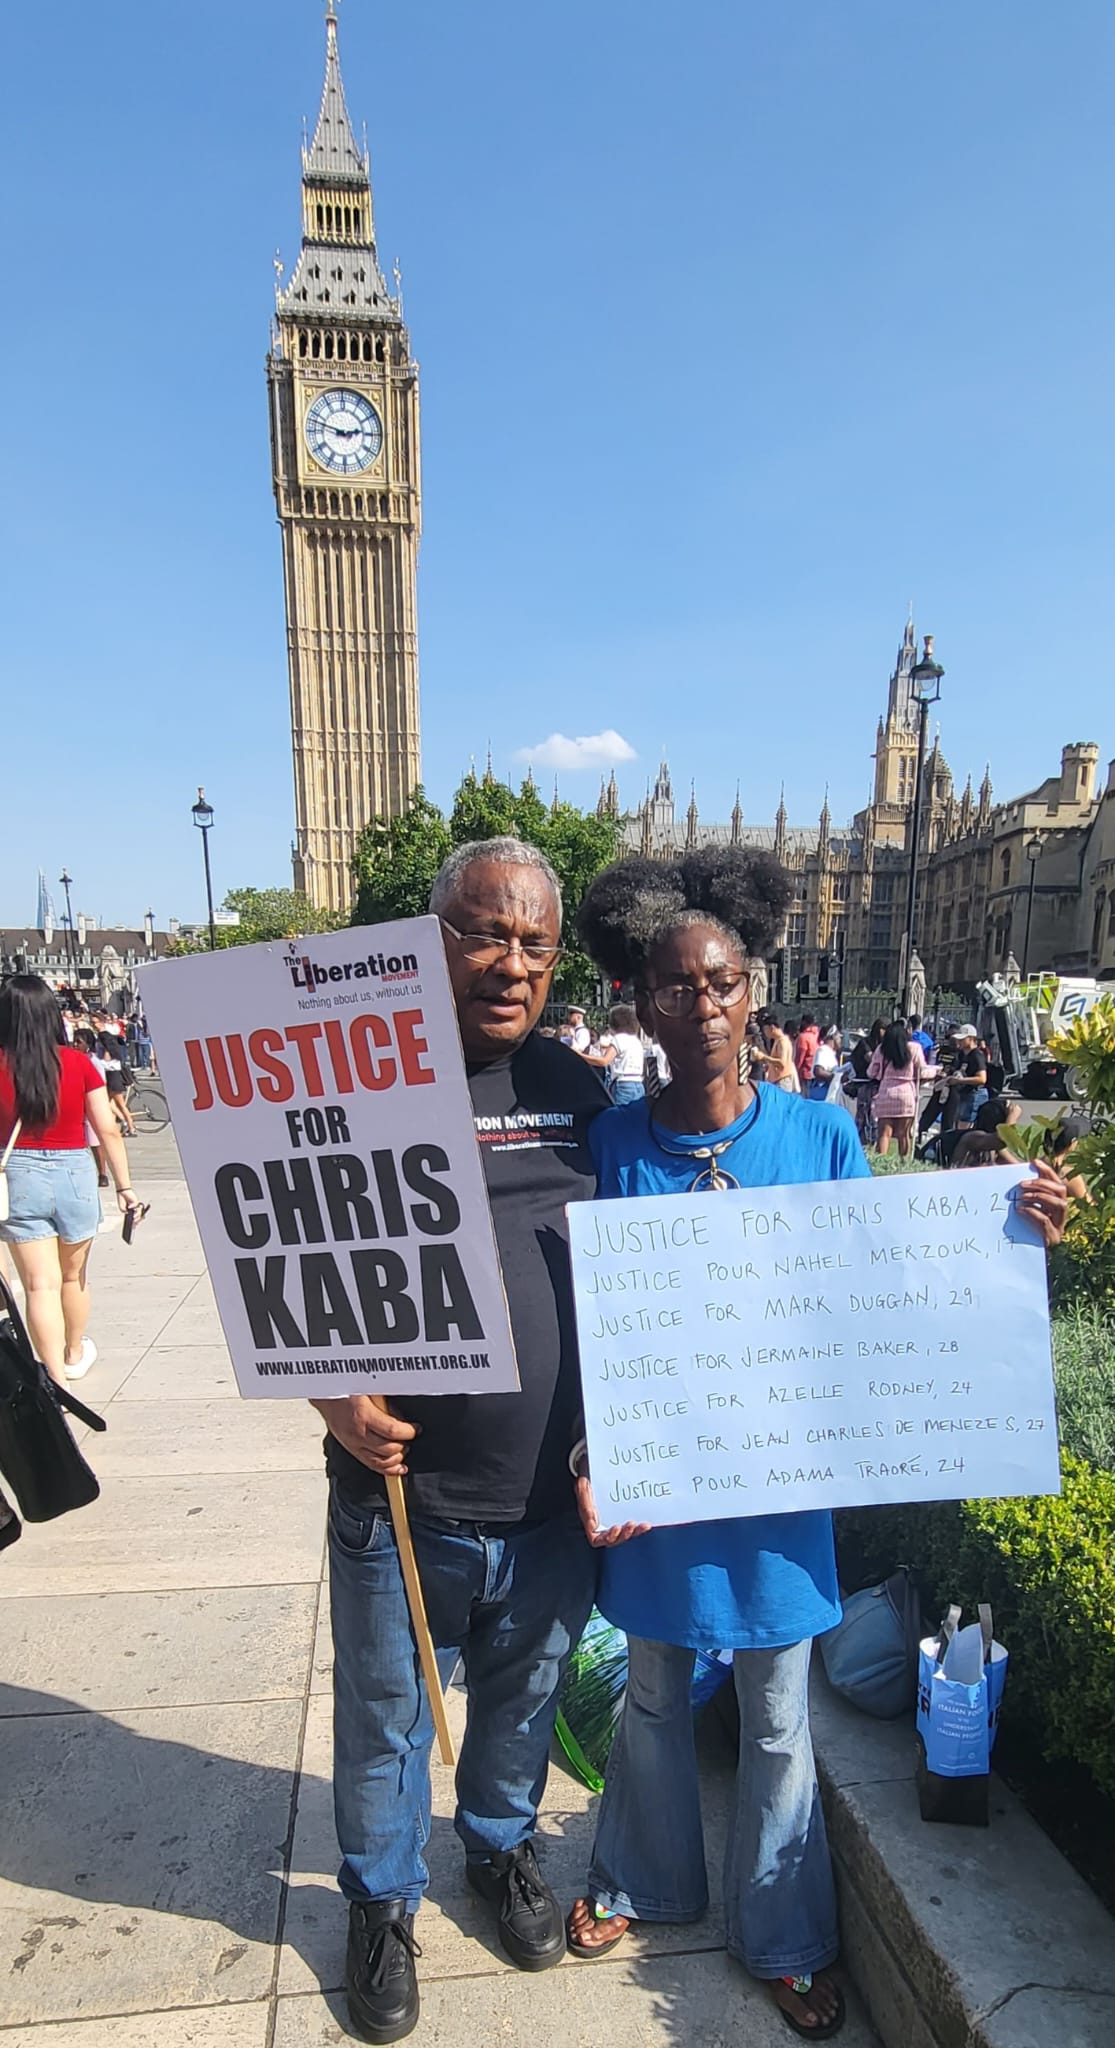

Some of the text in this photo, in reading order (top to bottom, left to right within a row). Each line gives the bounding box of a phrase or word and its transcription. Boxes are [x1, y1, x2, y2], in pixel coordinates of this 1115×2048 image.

[283, 955, 301, 967] The
[291, 953, 418, 988] Liberation
[382, 970, 419, 982] MOVEMENT
[298, 984, 422, 1010] Nothing about us, without us
[185, 1009, 436, 1111] JUSTICE
[285, 1105, 352, 1149] FOR
[504, 1113, 574, 1130] MOVEMENT
[507, 1130, 529, 1140] about
[214, 1144, 461, 1249] CHRIS
[583, 1215, 709, 1257] JUSTICE
[741, 1209, 792, 1238] FOR
[811, 1202, 882, 1230] CHRIS
[908, 1195, 978, 1219] KABA,
[586, 1235, 1015, 1294] JUSTICE POUR NAHEL MERZOUK, 17
[235, 1244, 486, 1349] KABA
[592, 1285, 973, 1338] JUSTICE FOR MARK DUGGAN, 29
[255, 1353, 490, 1376] WWW.LIBERATIONMOVEMENT.ORG.UK
[600, 1353, 679, 1381] JUSTICE
[695, 1352, 732, 1370] FOR
[741, 1343, 844, 1368] JERMAINE
[938, 1340, 959, 1354] 28
[603, 1379, 973, 1427] JUSTICE FOR AZELLE RODNEY, 24
[609, 1442, 680, 1466] JUSTICE
[697, 1435, 729, 1452] FOR
[742, 1429, 789, 1450] JEAN
[806, 1421, 885, 1443] CHARLES
[896, 1420, 915, 1435] DE
[1026, 1418, 1046, 1431] 27
[609, 1455, 966, 1503] JUSTICE POUR ADAMA TRAORÉ, 24
[938, 1703, 966, 1715] ITALIAN
